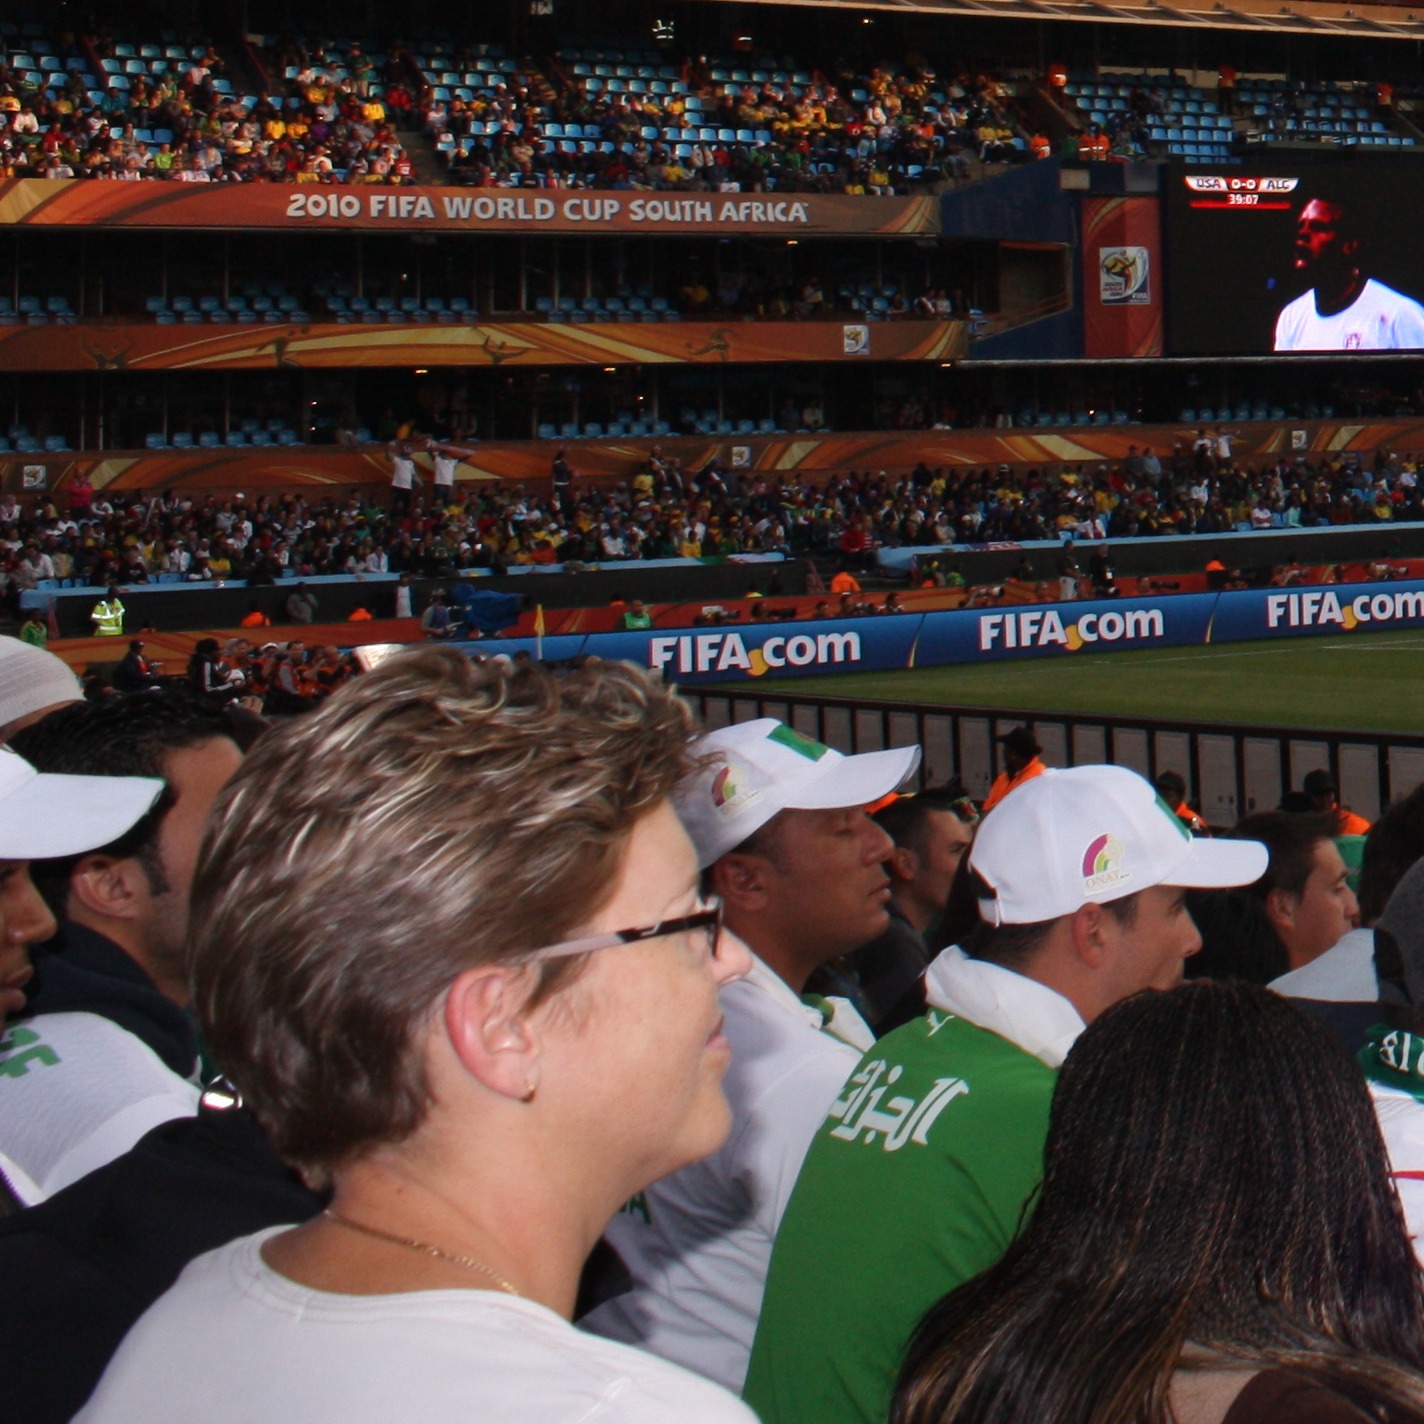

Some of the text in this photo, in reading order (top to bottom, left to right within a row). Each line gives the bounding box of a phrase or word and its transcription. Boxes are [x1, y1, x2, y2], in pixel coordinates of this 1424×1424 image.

[1196, 178, 1221, 189] USA
[286, 193, 361, 219] 2010
[370, 195, 435, 219] FIFA
[443, 196, 555, 220] WORLD
[563, 198, 620, 221] CUP
[629, 199, 713, 222] SOUTH
[978, 609, 1164, 651] FIFA.com
[650, 631, 861, 676] FIFA.com
